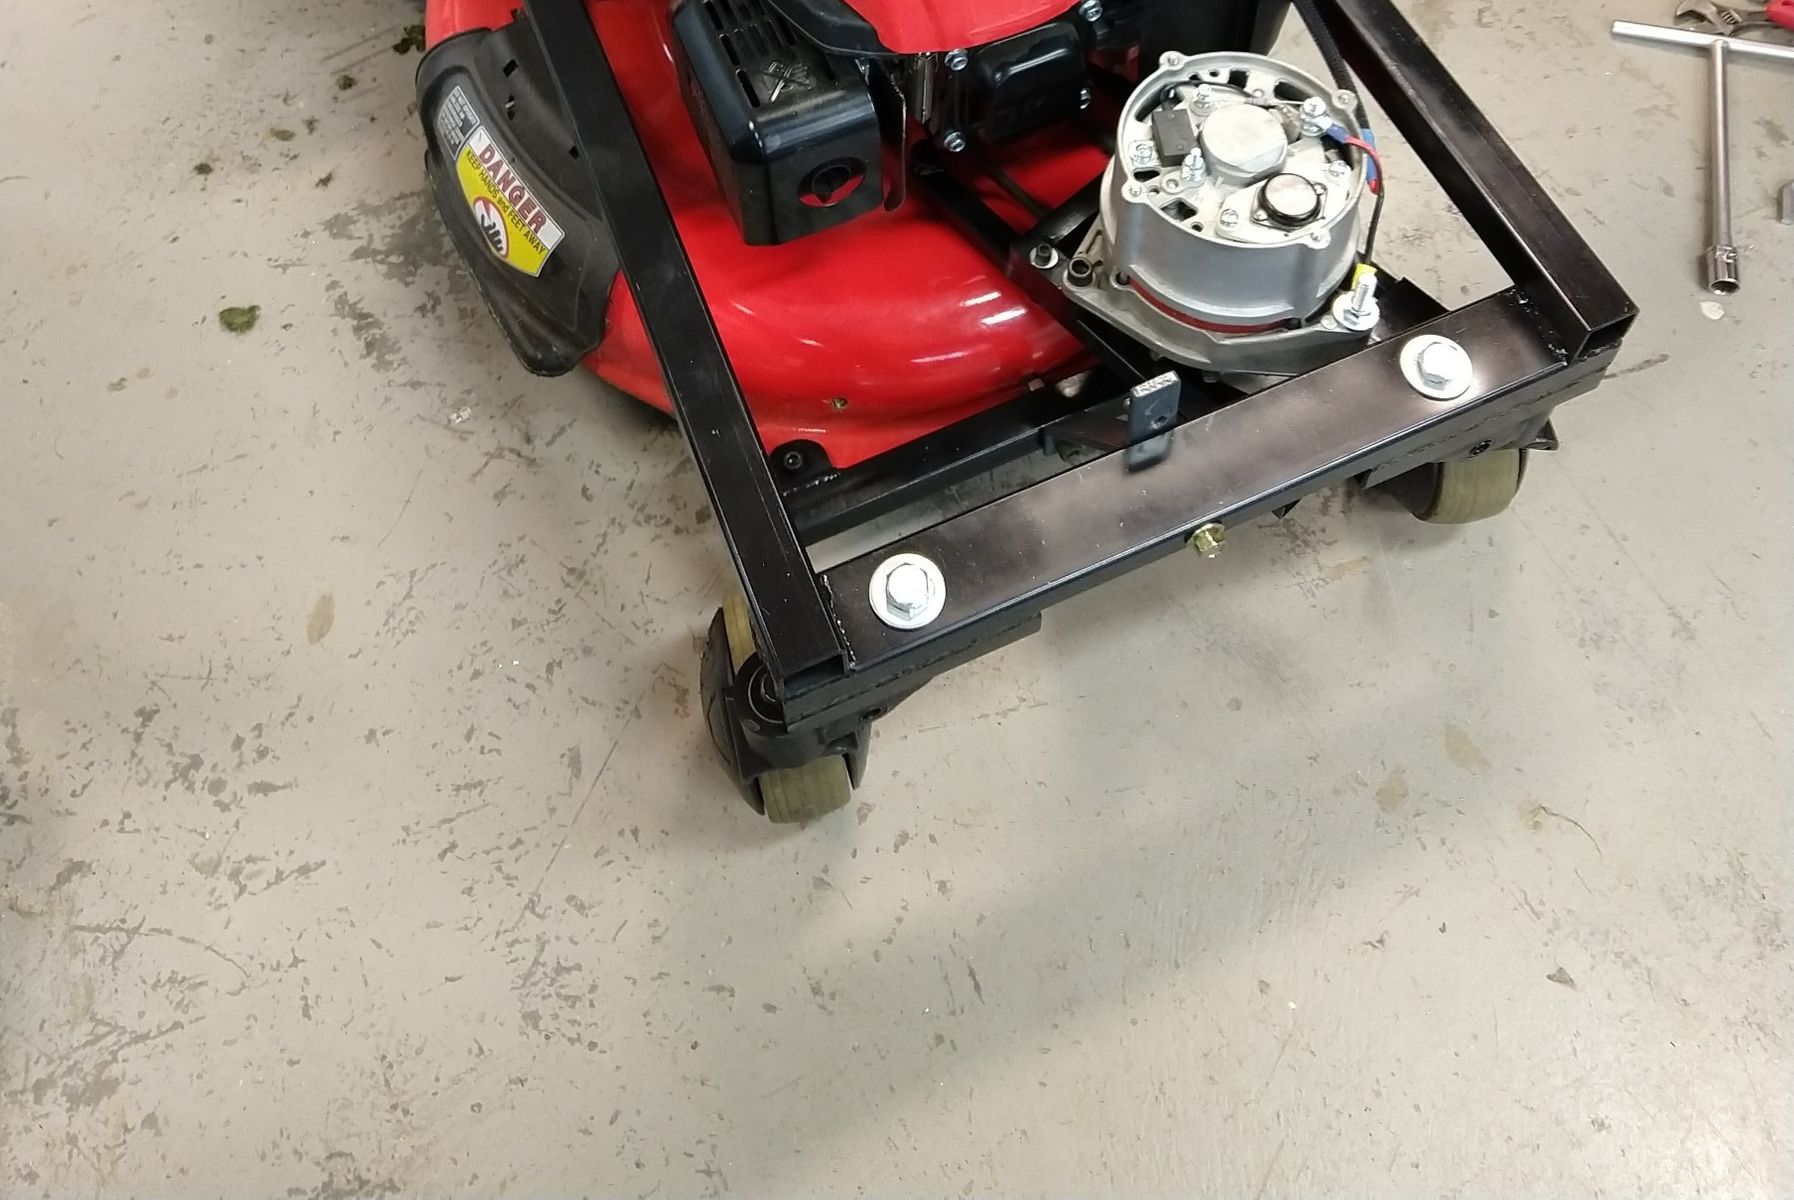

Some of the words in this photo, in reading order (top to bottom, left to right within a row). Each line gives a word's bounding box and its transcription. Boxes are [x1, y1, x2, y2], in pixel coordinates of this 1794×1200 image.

[466, 150, 481, 170] KEEP
[478, 169, 500, 198] HANDS
[497, 197, 511, 213] and
[507, 209, 526, 232] FEET
[523, 230, 546, 254] AWAY
[479, 144, 546, 234] DANGER
